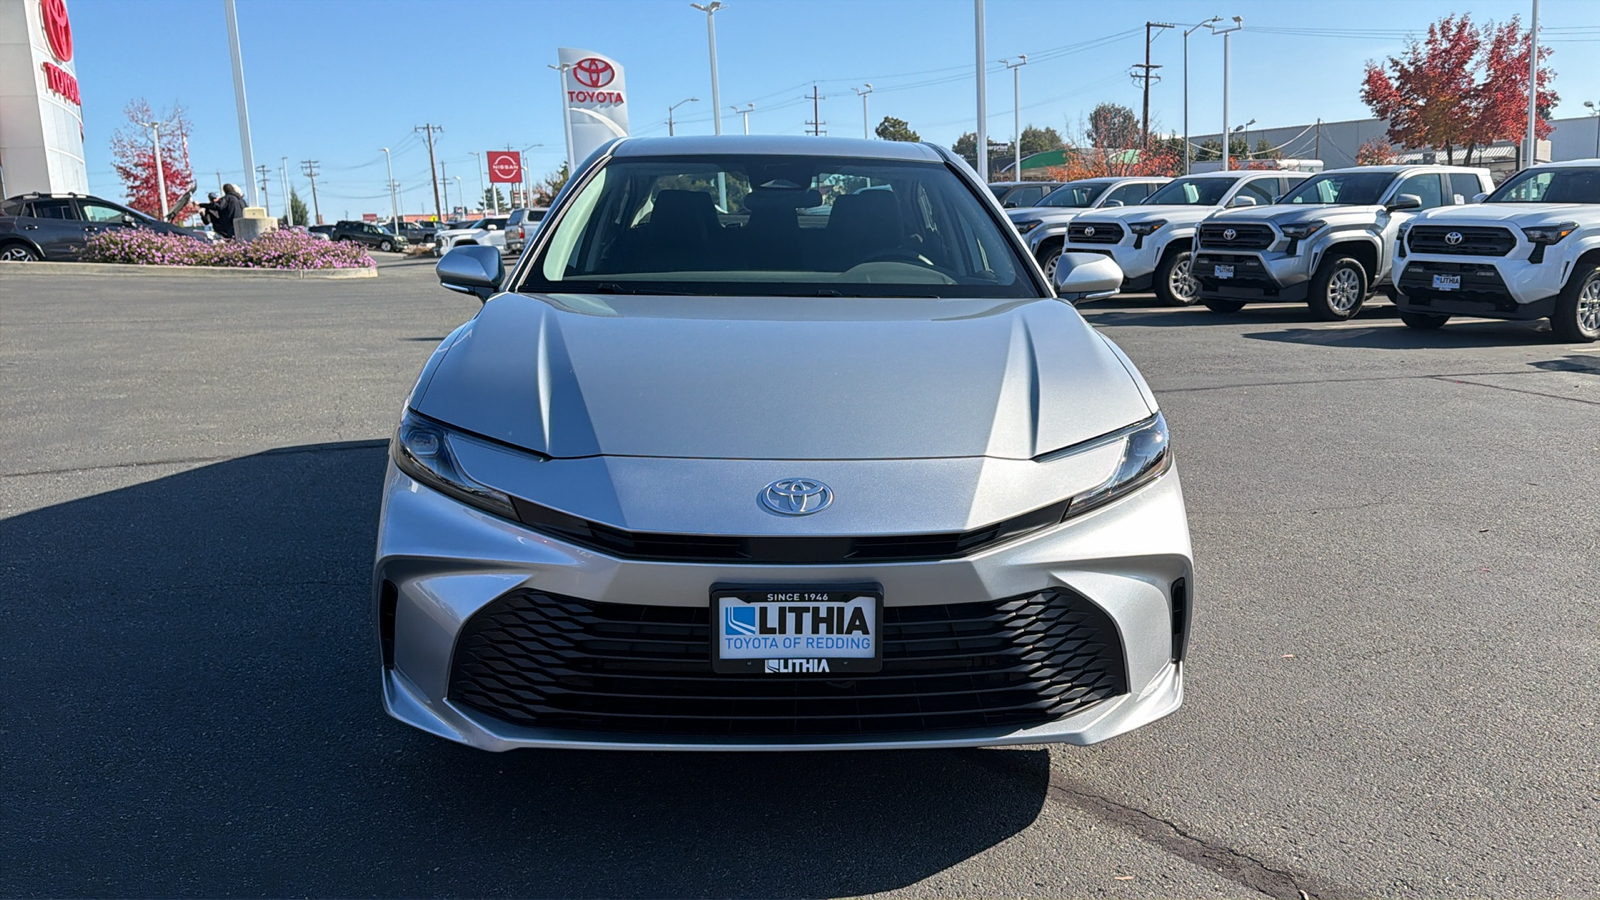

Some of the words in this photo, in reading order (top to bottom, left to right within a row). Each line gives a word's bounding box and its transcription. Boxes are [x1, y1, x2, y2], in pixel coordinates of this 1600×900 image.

[567, 91, 624, 103] TOYOTA
[767, 593, 800, 601] SINCE
[804, 593, 829, 601] 1946
[759, 606, 870, 635] LITHIA
[725, 637, 779, 650] TOYOTA
[783, 637, 802, 650] OF
[806, 637, 871, 650] REDDING
[779, 659, 831, 673] LITHIA
